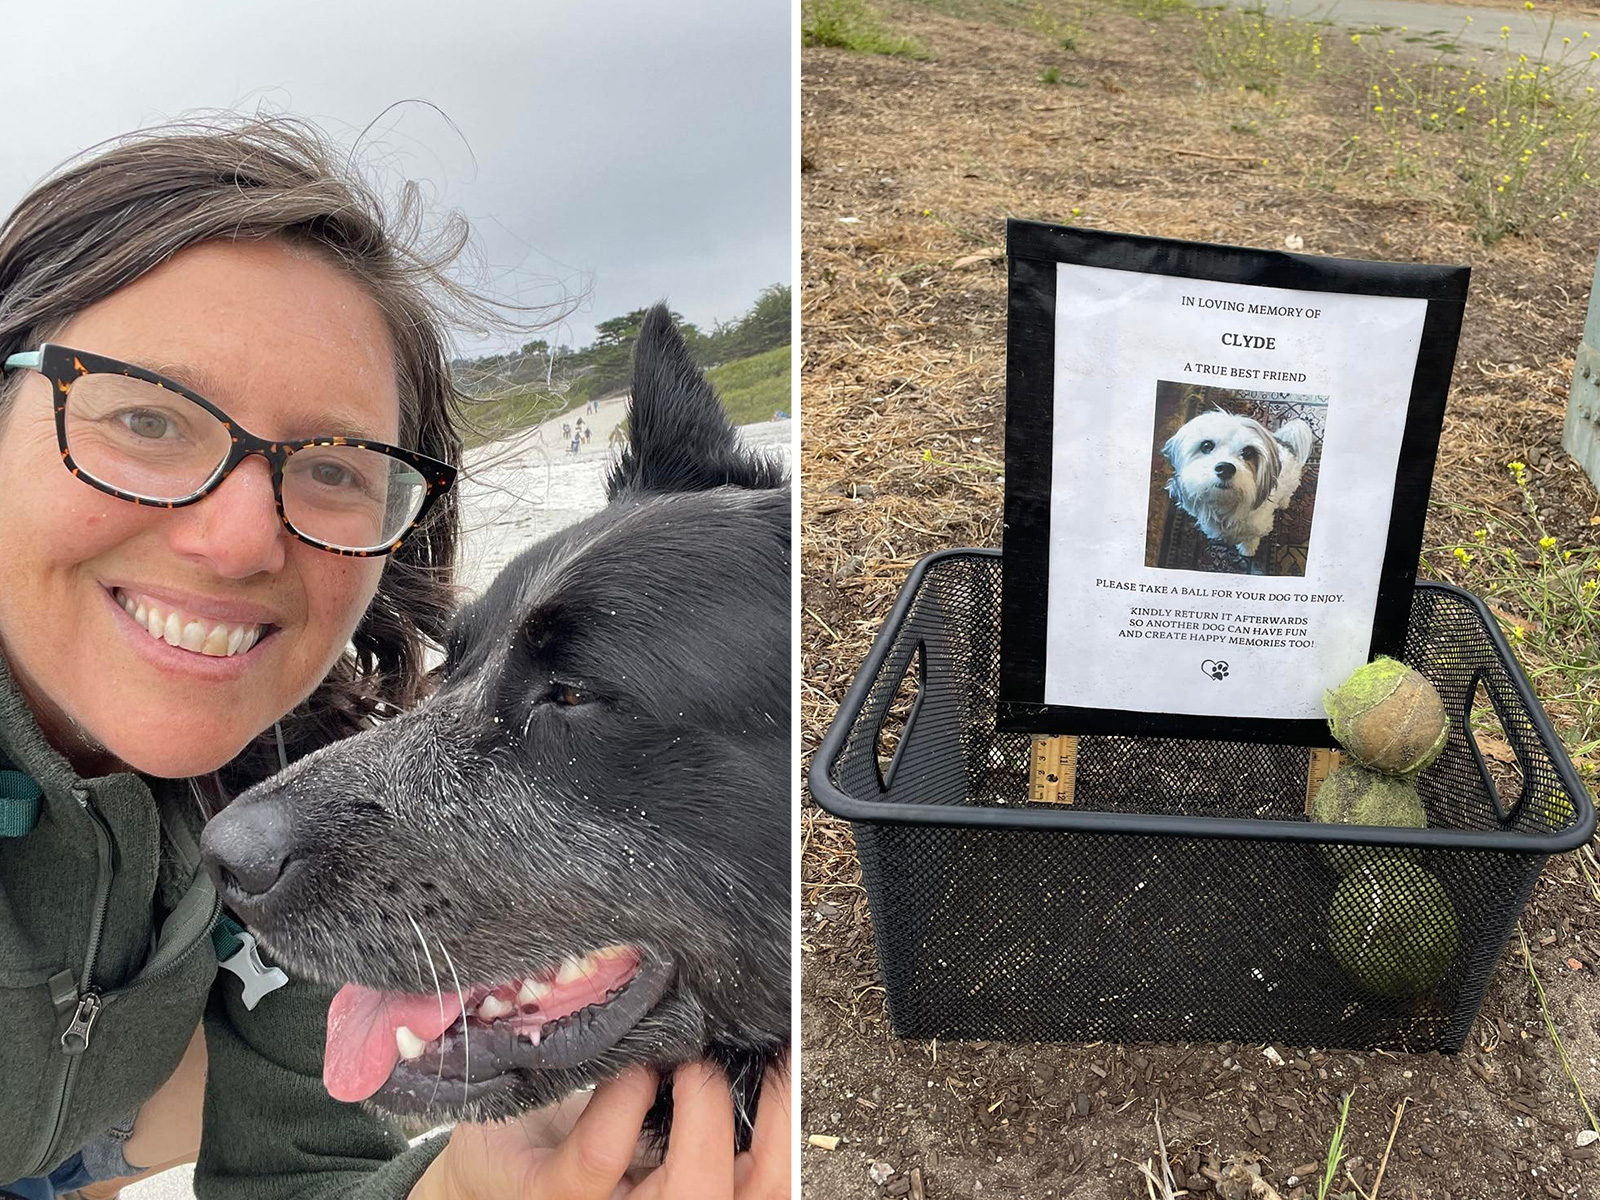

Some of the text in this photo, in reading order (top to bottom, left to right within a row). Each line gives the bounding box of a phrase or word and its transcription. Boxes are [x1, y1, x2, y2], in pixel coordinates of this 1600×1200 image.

[1181, 296, 1321, 319] IN LOVING MEMORY OF
[1221, 332, 1276, 350] CLYDE
[1183, 362, 1307, 382] A TRUE BEST FRIEND
[1096, 578, 1345, 604] PLEASE TAKE A BALL FOR YOUR DOG TO ENJOY.
[1130, 607, 1308, 625] KINDLY RETURN IT AFTERWARDS
[1129, 618, 1307, 637] SO ANOTHER DOG CAN HAVE FUN
[1118, 629, 1315, 648] AND CREATE HAPPY MEMORIES TOO!
[1057, 792, 1066, 800] 12
